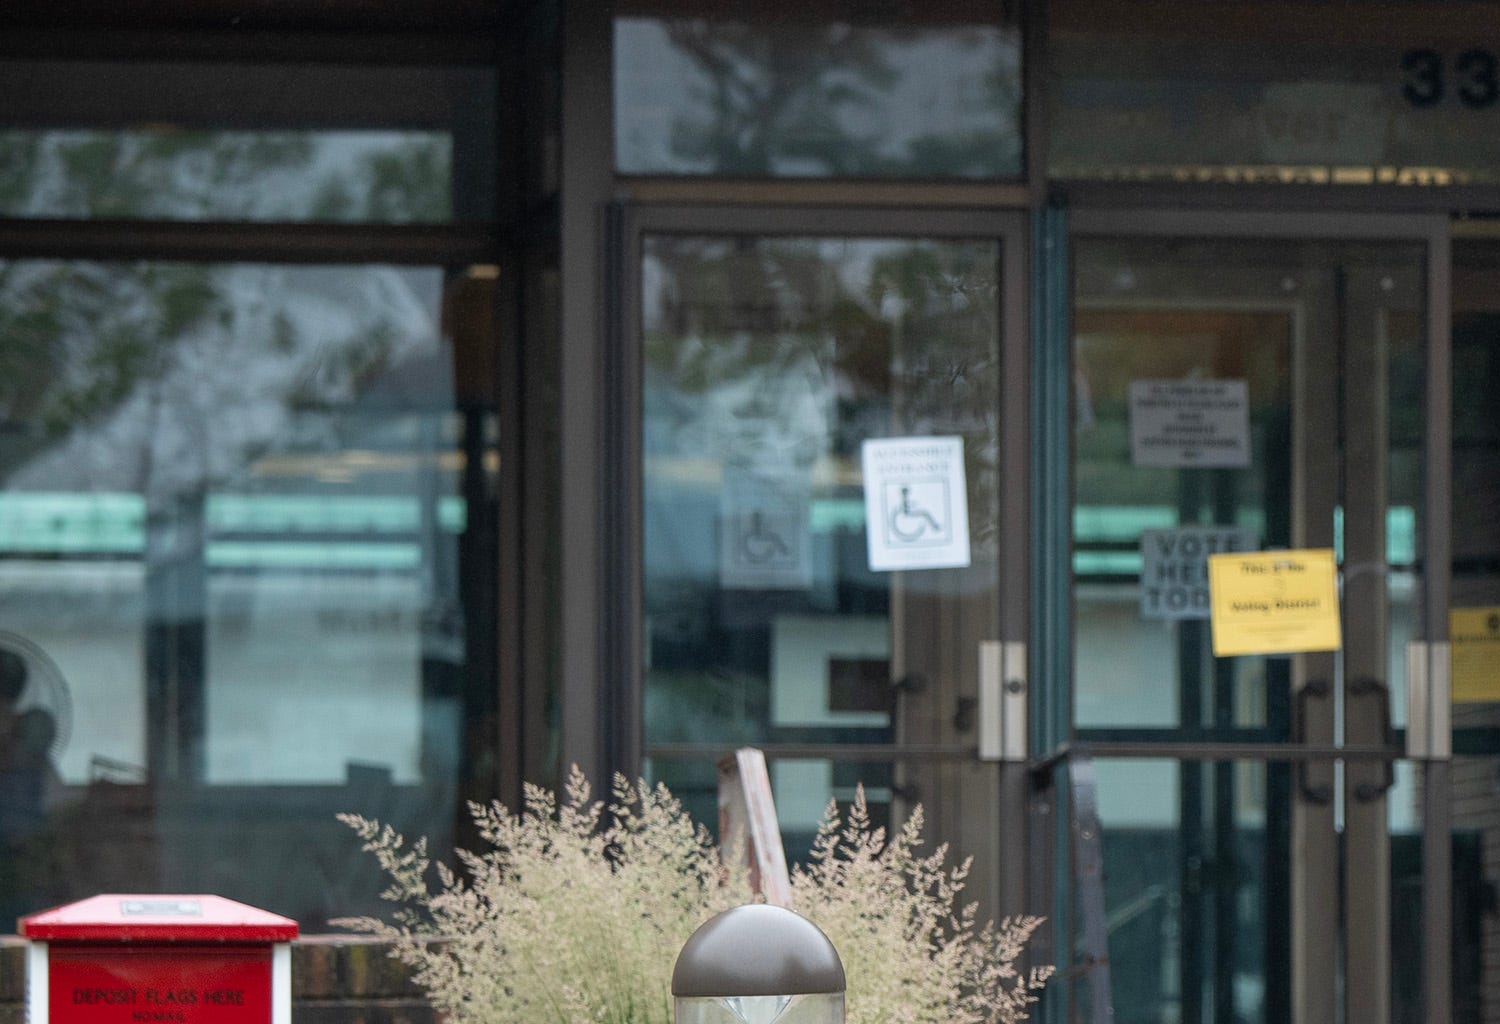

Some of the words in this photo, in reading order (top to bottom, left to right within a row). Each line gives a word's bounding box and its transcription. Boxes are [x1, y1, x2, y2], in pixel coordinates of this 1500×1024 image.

[1401, 51, 1498, 108] 33
[1155, 533, 1241, 555] VOTE
[72, 988, 137, 1004] DEPOSIT
[145, 988, 198, 1004] FLAGS
[204, 989, 244, 1005] HERE
[133, 1011, 150, 1022] NO
[153, 1011, 185, 1022] MAIL
